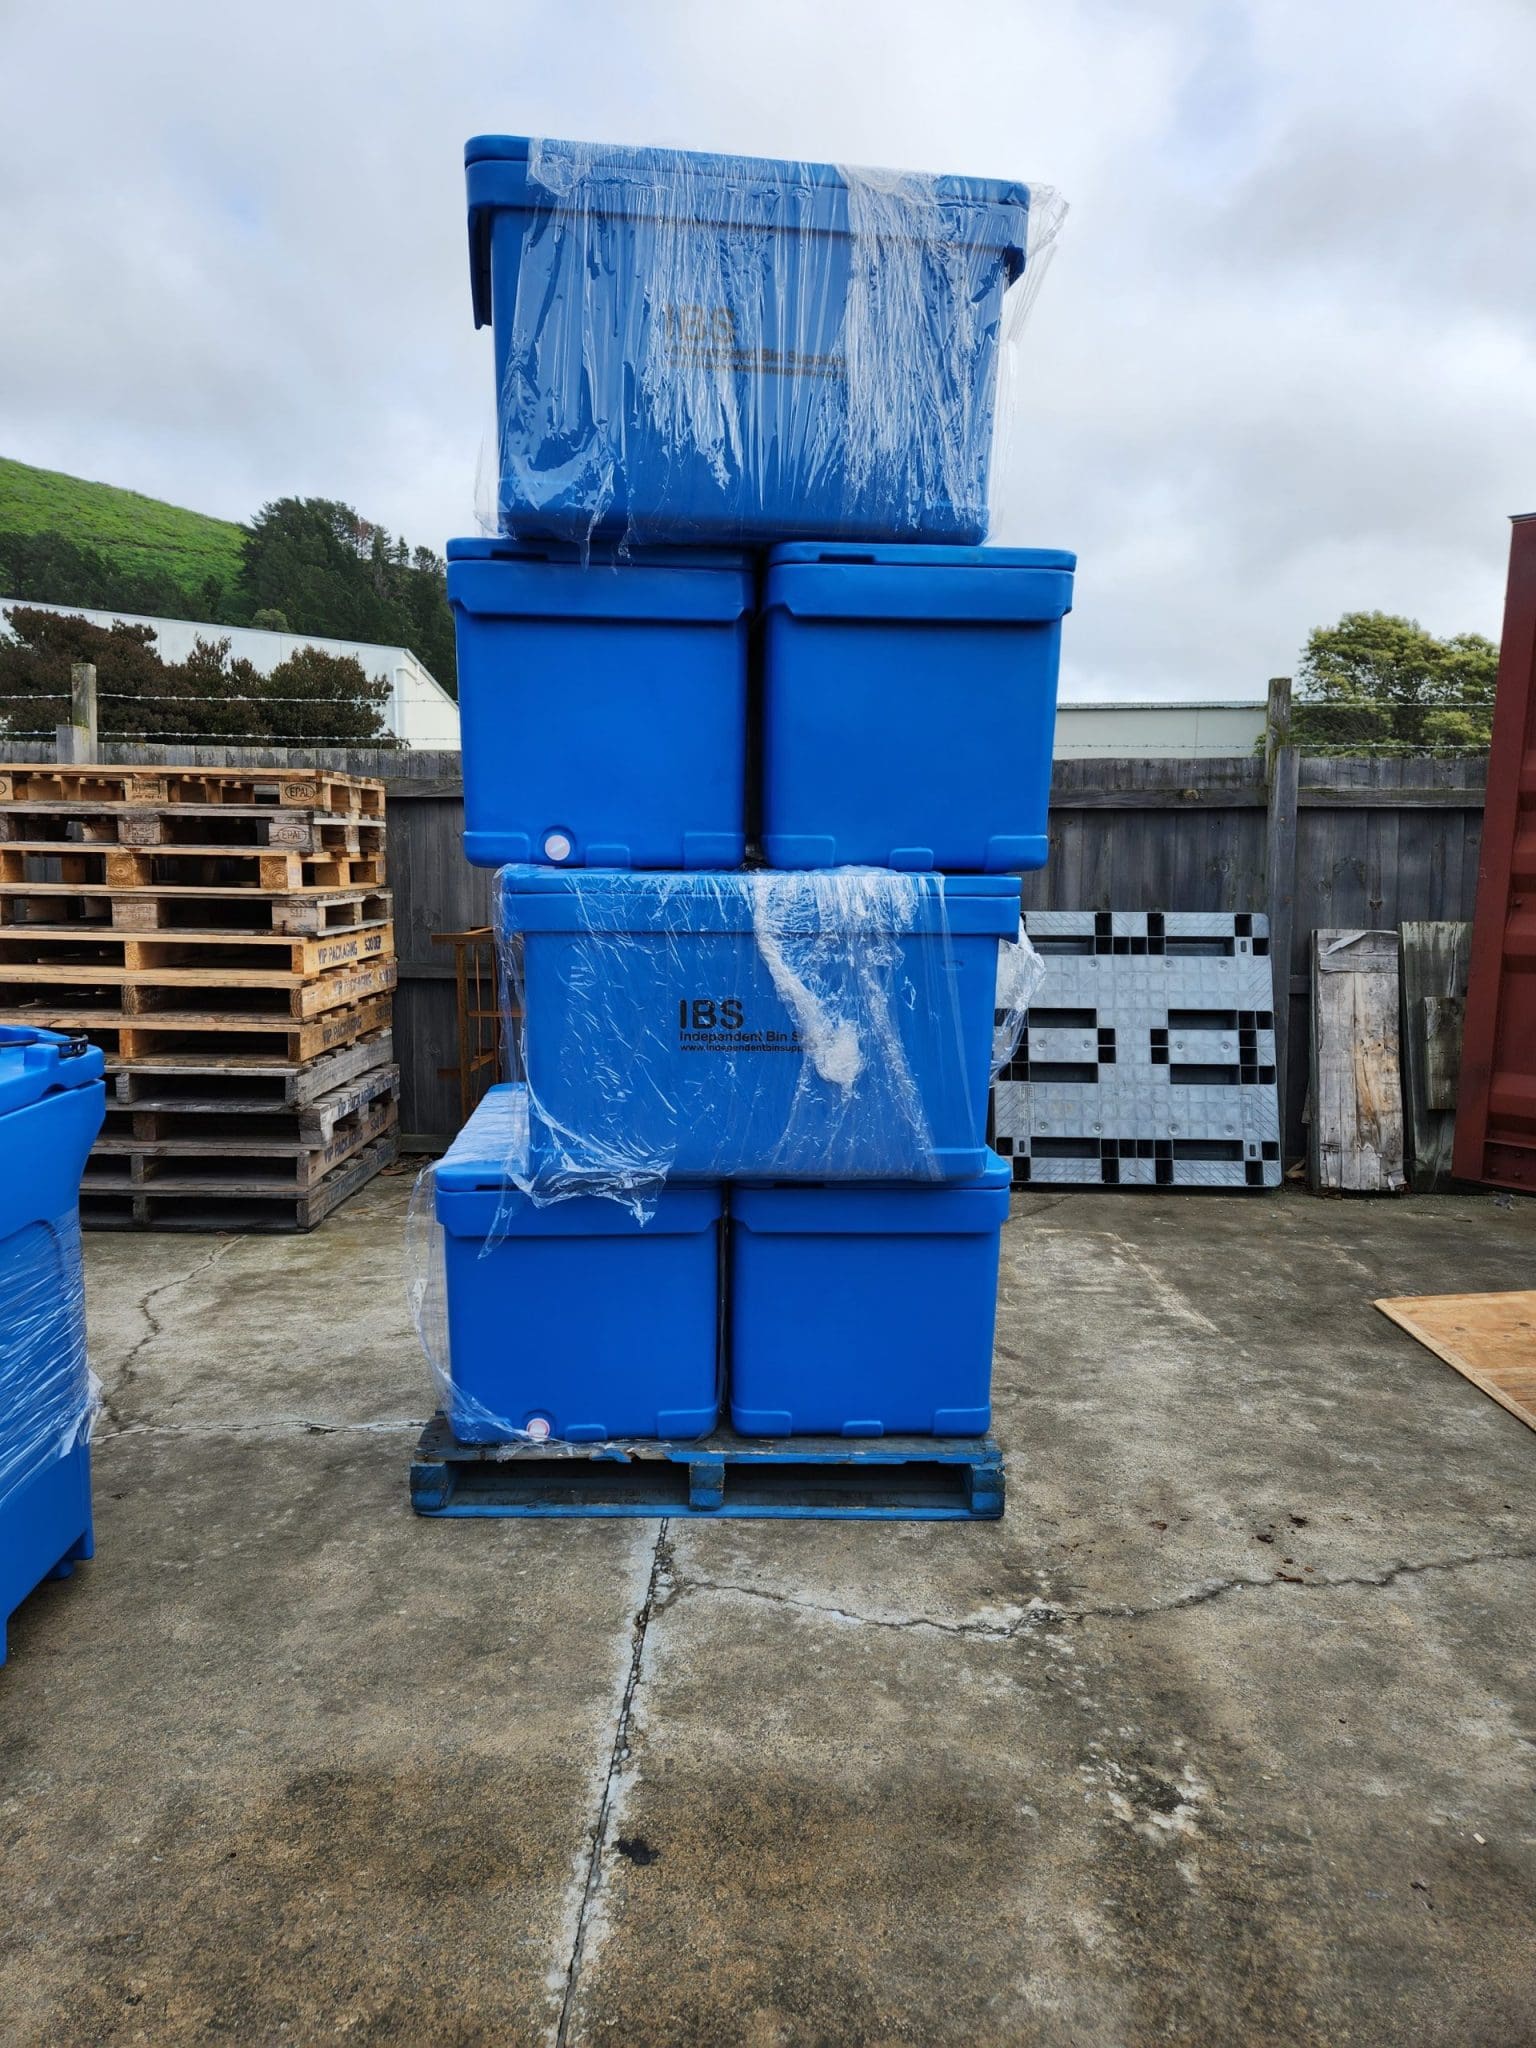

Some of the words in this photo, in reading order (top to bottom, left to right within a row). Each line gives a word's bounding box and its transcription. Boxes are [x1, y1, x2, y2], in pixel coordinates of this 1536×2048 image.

[664, 303, 735, 343] IBS
[318, 948, 327, 964] VIP
[329, 940, 358, 960] PACKAGING
[680, 999, 744, 1030] IBS
[680, 1031, 763, 1044] Independent
[766, 1030, 788, 1042] Bin
